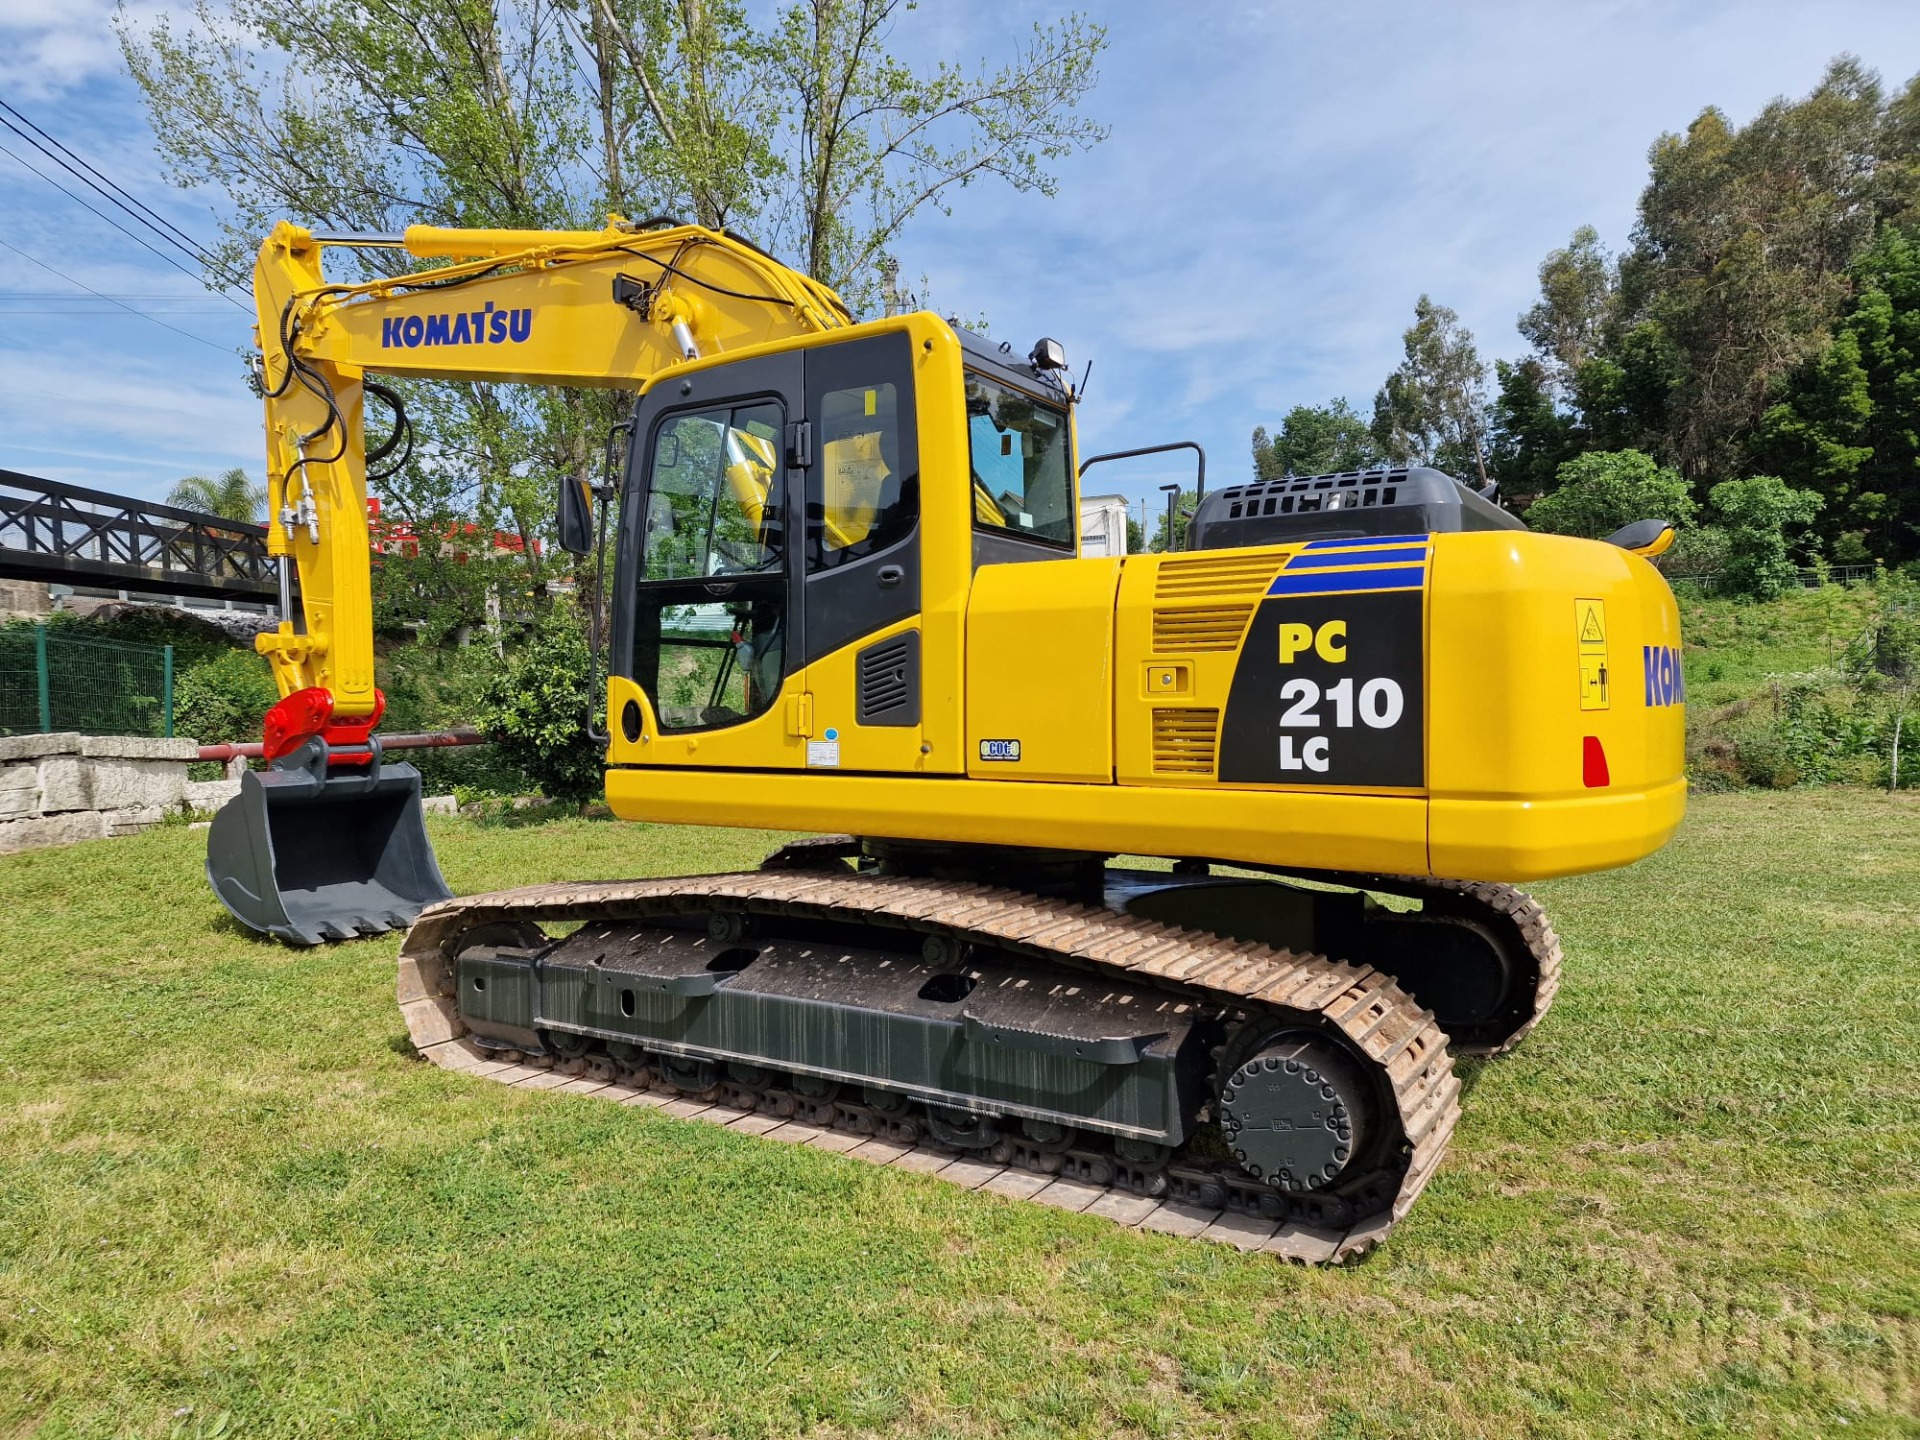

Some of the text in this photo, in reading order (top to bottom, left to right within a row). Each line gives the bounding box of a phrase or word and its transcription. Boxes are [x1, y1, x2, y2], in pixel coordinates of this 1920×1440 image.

[382, 301, 532, 348] KOMATSU
[1279, 620, 1347, 664] PC
[1279, 677, 1404, 729] 210
[1279, 736, 1329, 772] LC
